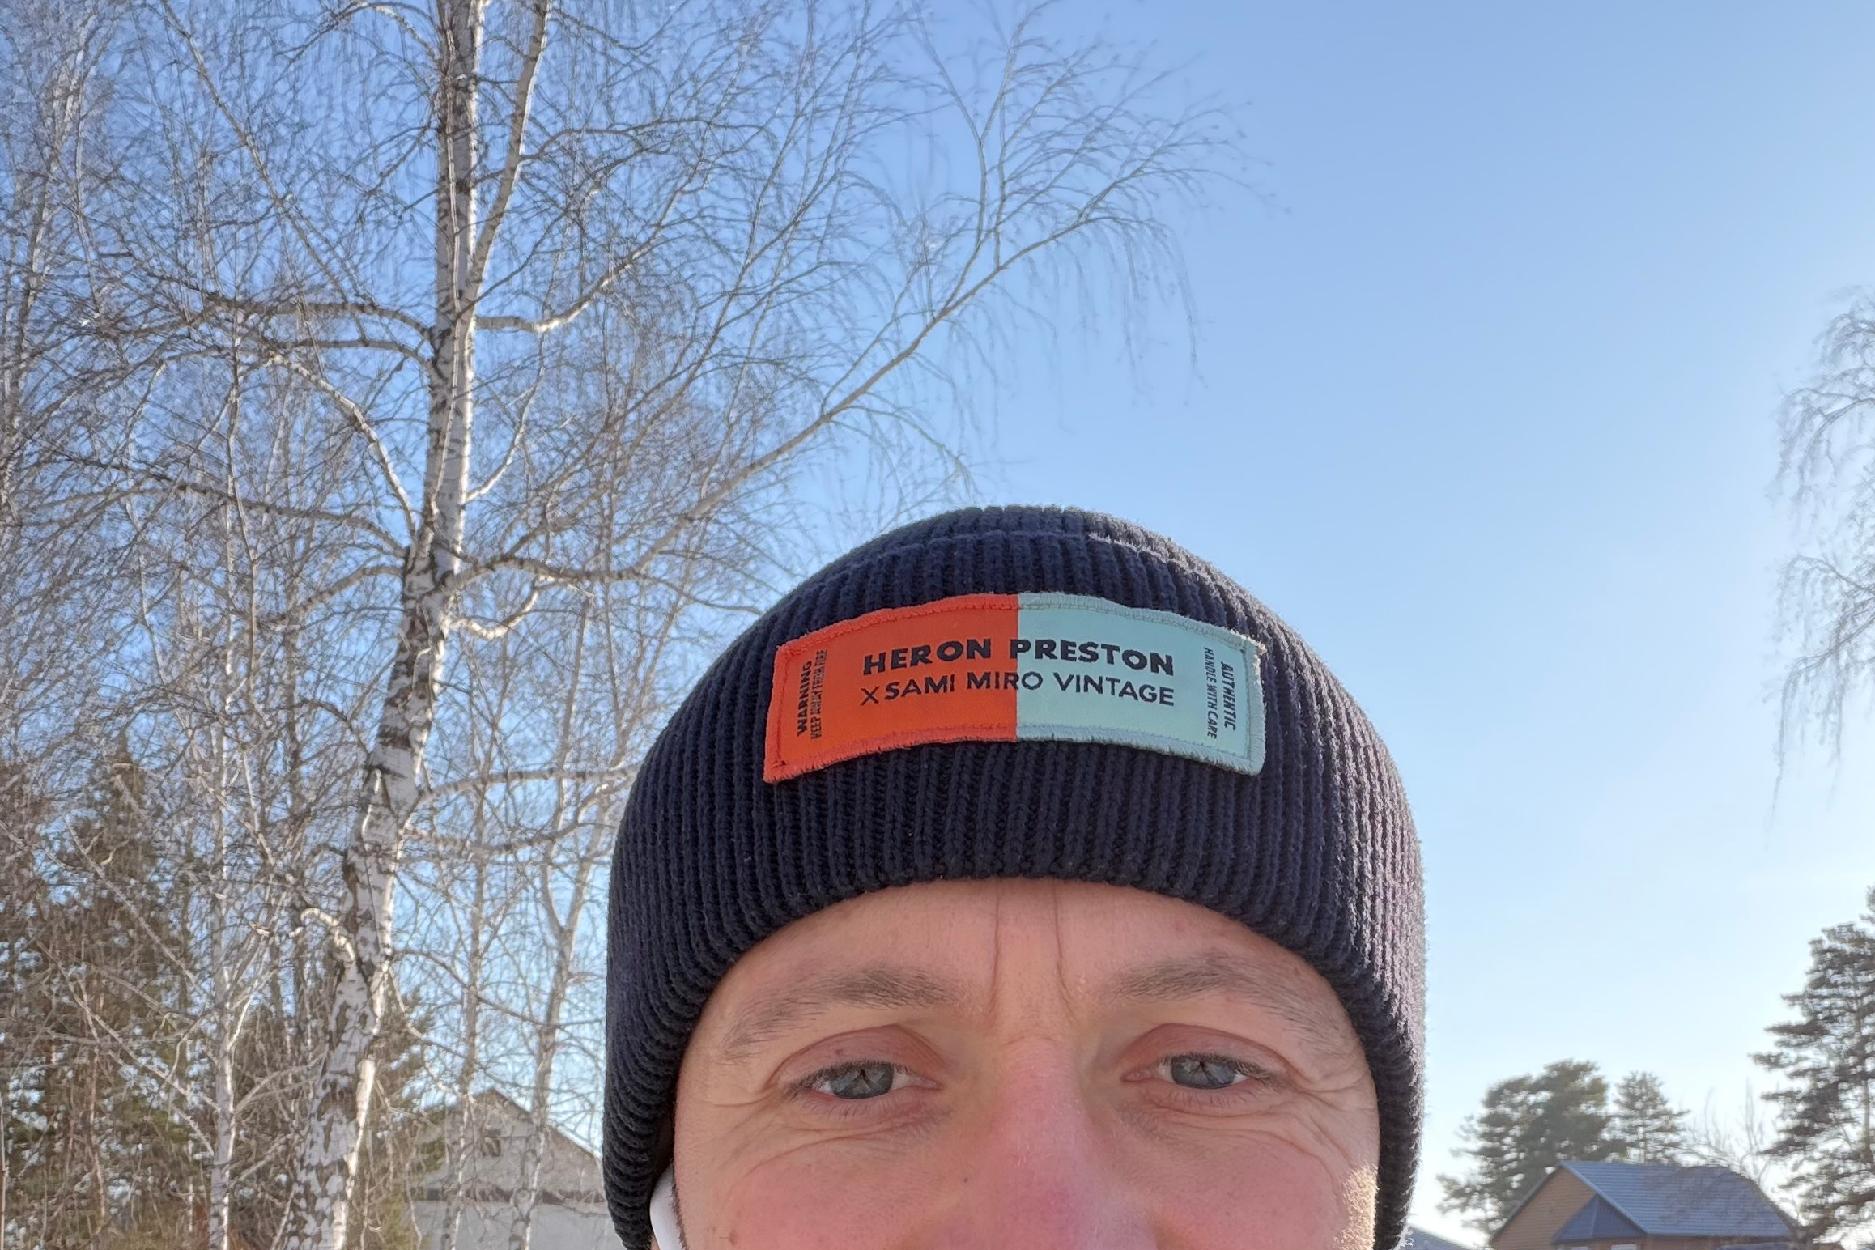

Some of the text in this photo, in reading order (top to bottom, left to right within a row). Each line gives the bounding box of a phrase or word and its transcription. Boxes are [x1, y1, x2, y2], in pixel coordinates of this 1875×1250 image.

[863, 638, 1174, 676] HERON PRESTON
[1205, 647, 1217, 683] HANDLE
[796, 661, 812, 736] WARNING
[885, 674, 955, 700] SAMI
[967, 671, 1043, 690] MIRO
[1053, 672, 1174, 706] VINTAGE
[1206, 684, 1218, 710] WITH
[1221, 661, 1236, 731] AUTHENTIC
